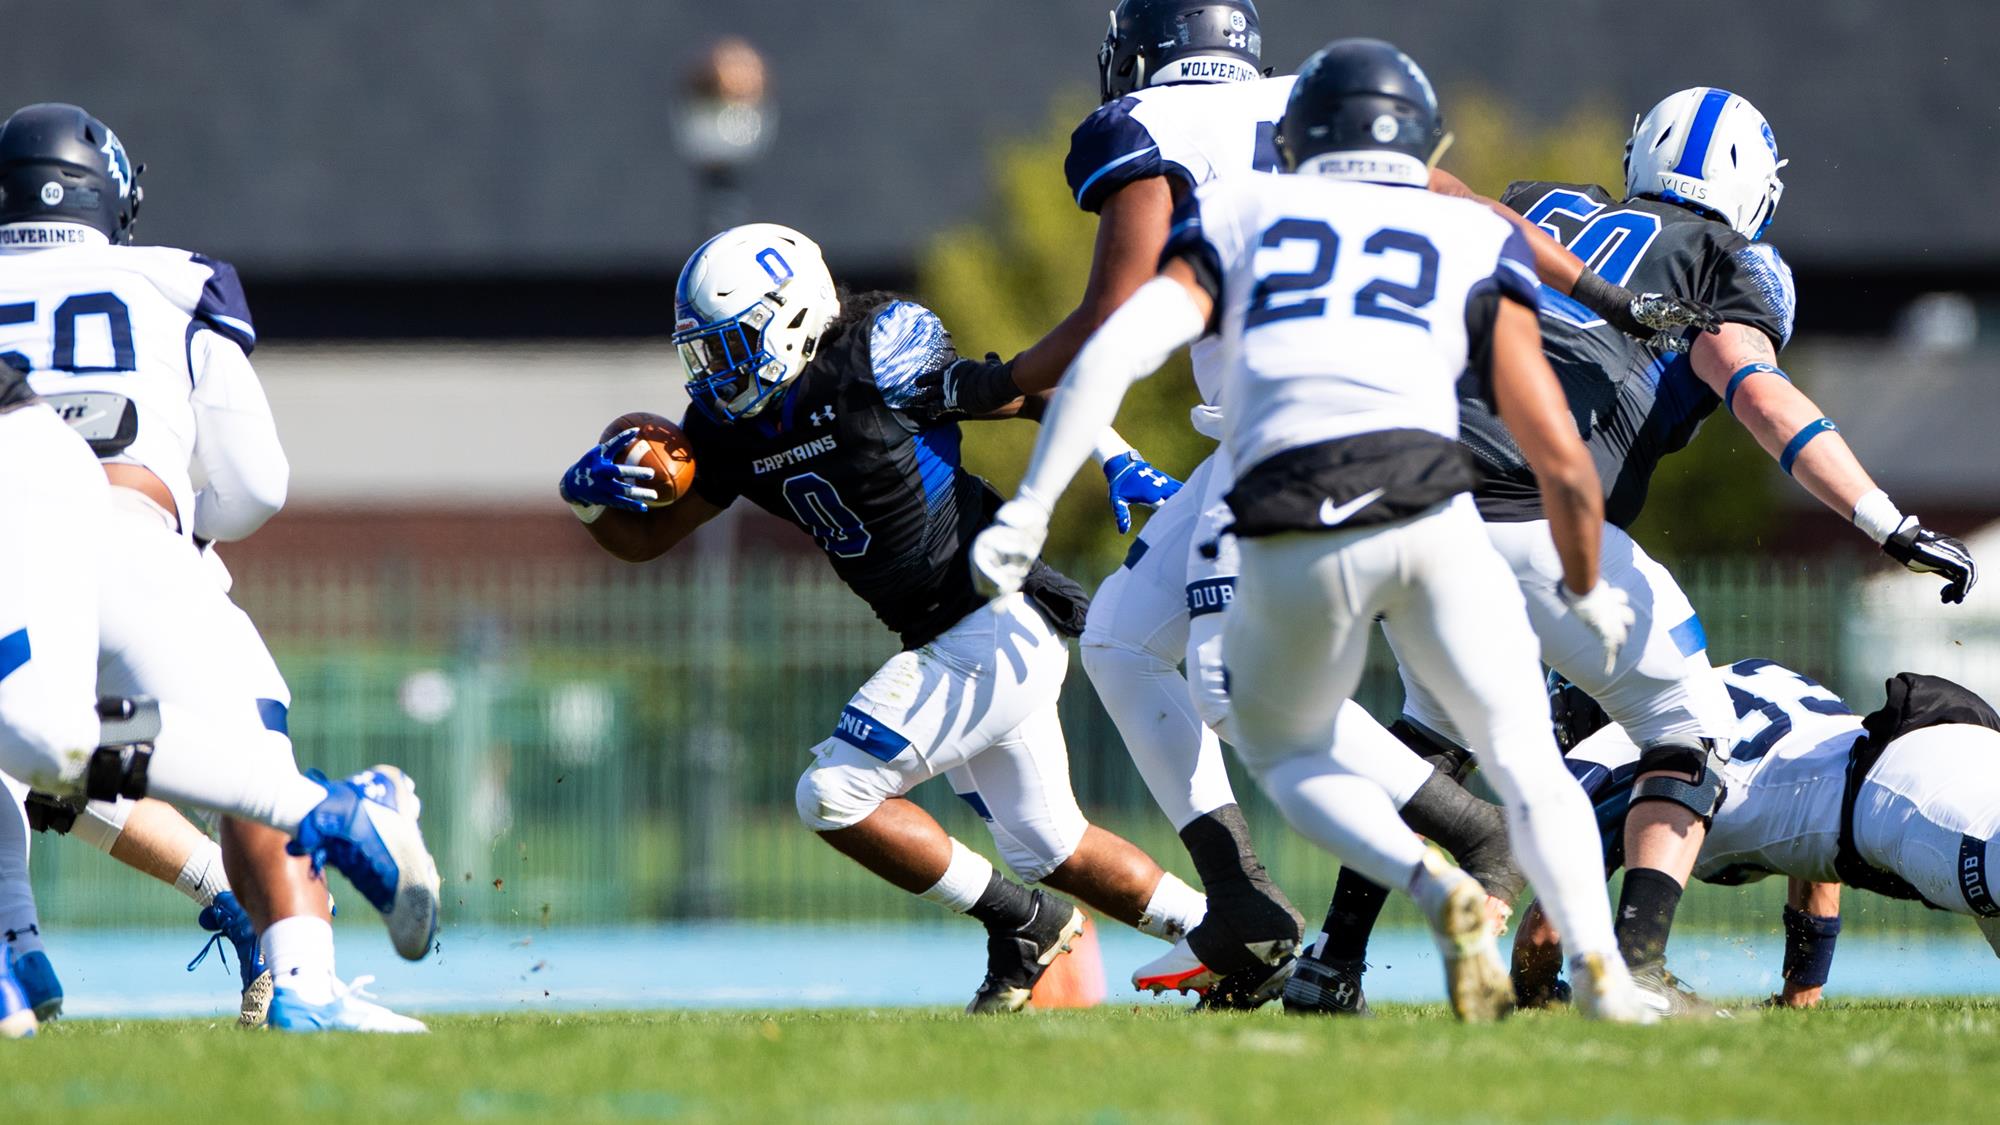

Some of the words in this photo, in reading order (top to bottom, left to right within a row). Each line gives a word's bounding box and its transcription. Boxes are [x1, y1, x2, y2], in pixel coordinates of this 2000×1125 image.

[1180, 61, 1257, 82] WOLVERINE
[1661, 178, 1708, 200] VICIS
[1244, 217, 1440, 333] 22
[752, 434, 837, 475] CAPTAINS
[782, 471, 871, 558] 0
[1192, 584, 1235, 609] DUB
